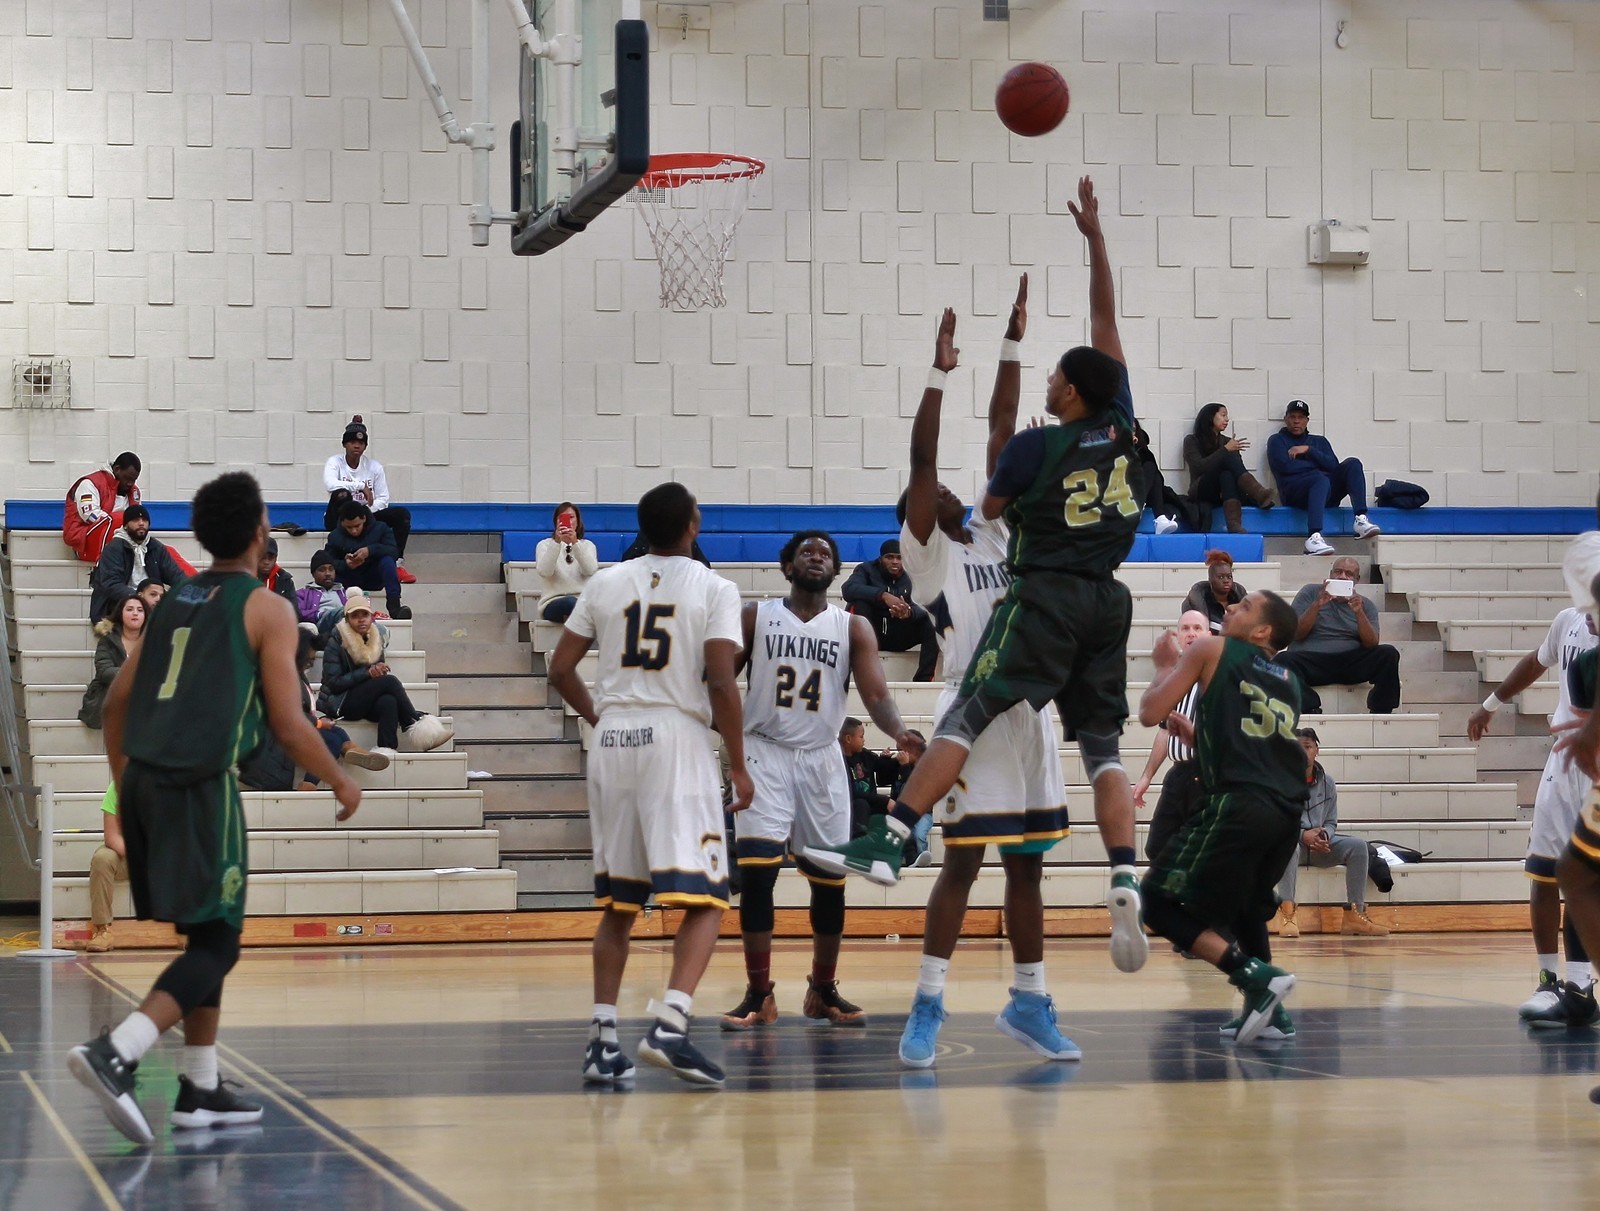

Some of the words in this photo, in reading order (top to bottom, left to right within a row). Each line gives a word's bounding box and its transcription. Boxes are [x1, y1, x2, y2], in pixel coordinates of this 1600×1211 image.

[1063, 455, 1140, 527] 24
[157, 626, 193, 700] 1
[621, 600, 676, 672] 15
[765, 634, 840, 669] VIKINGS
[775, 664, 822, 713] 24
